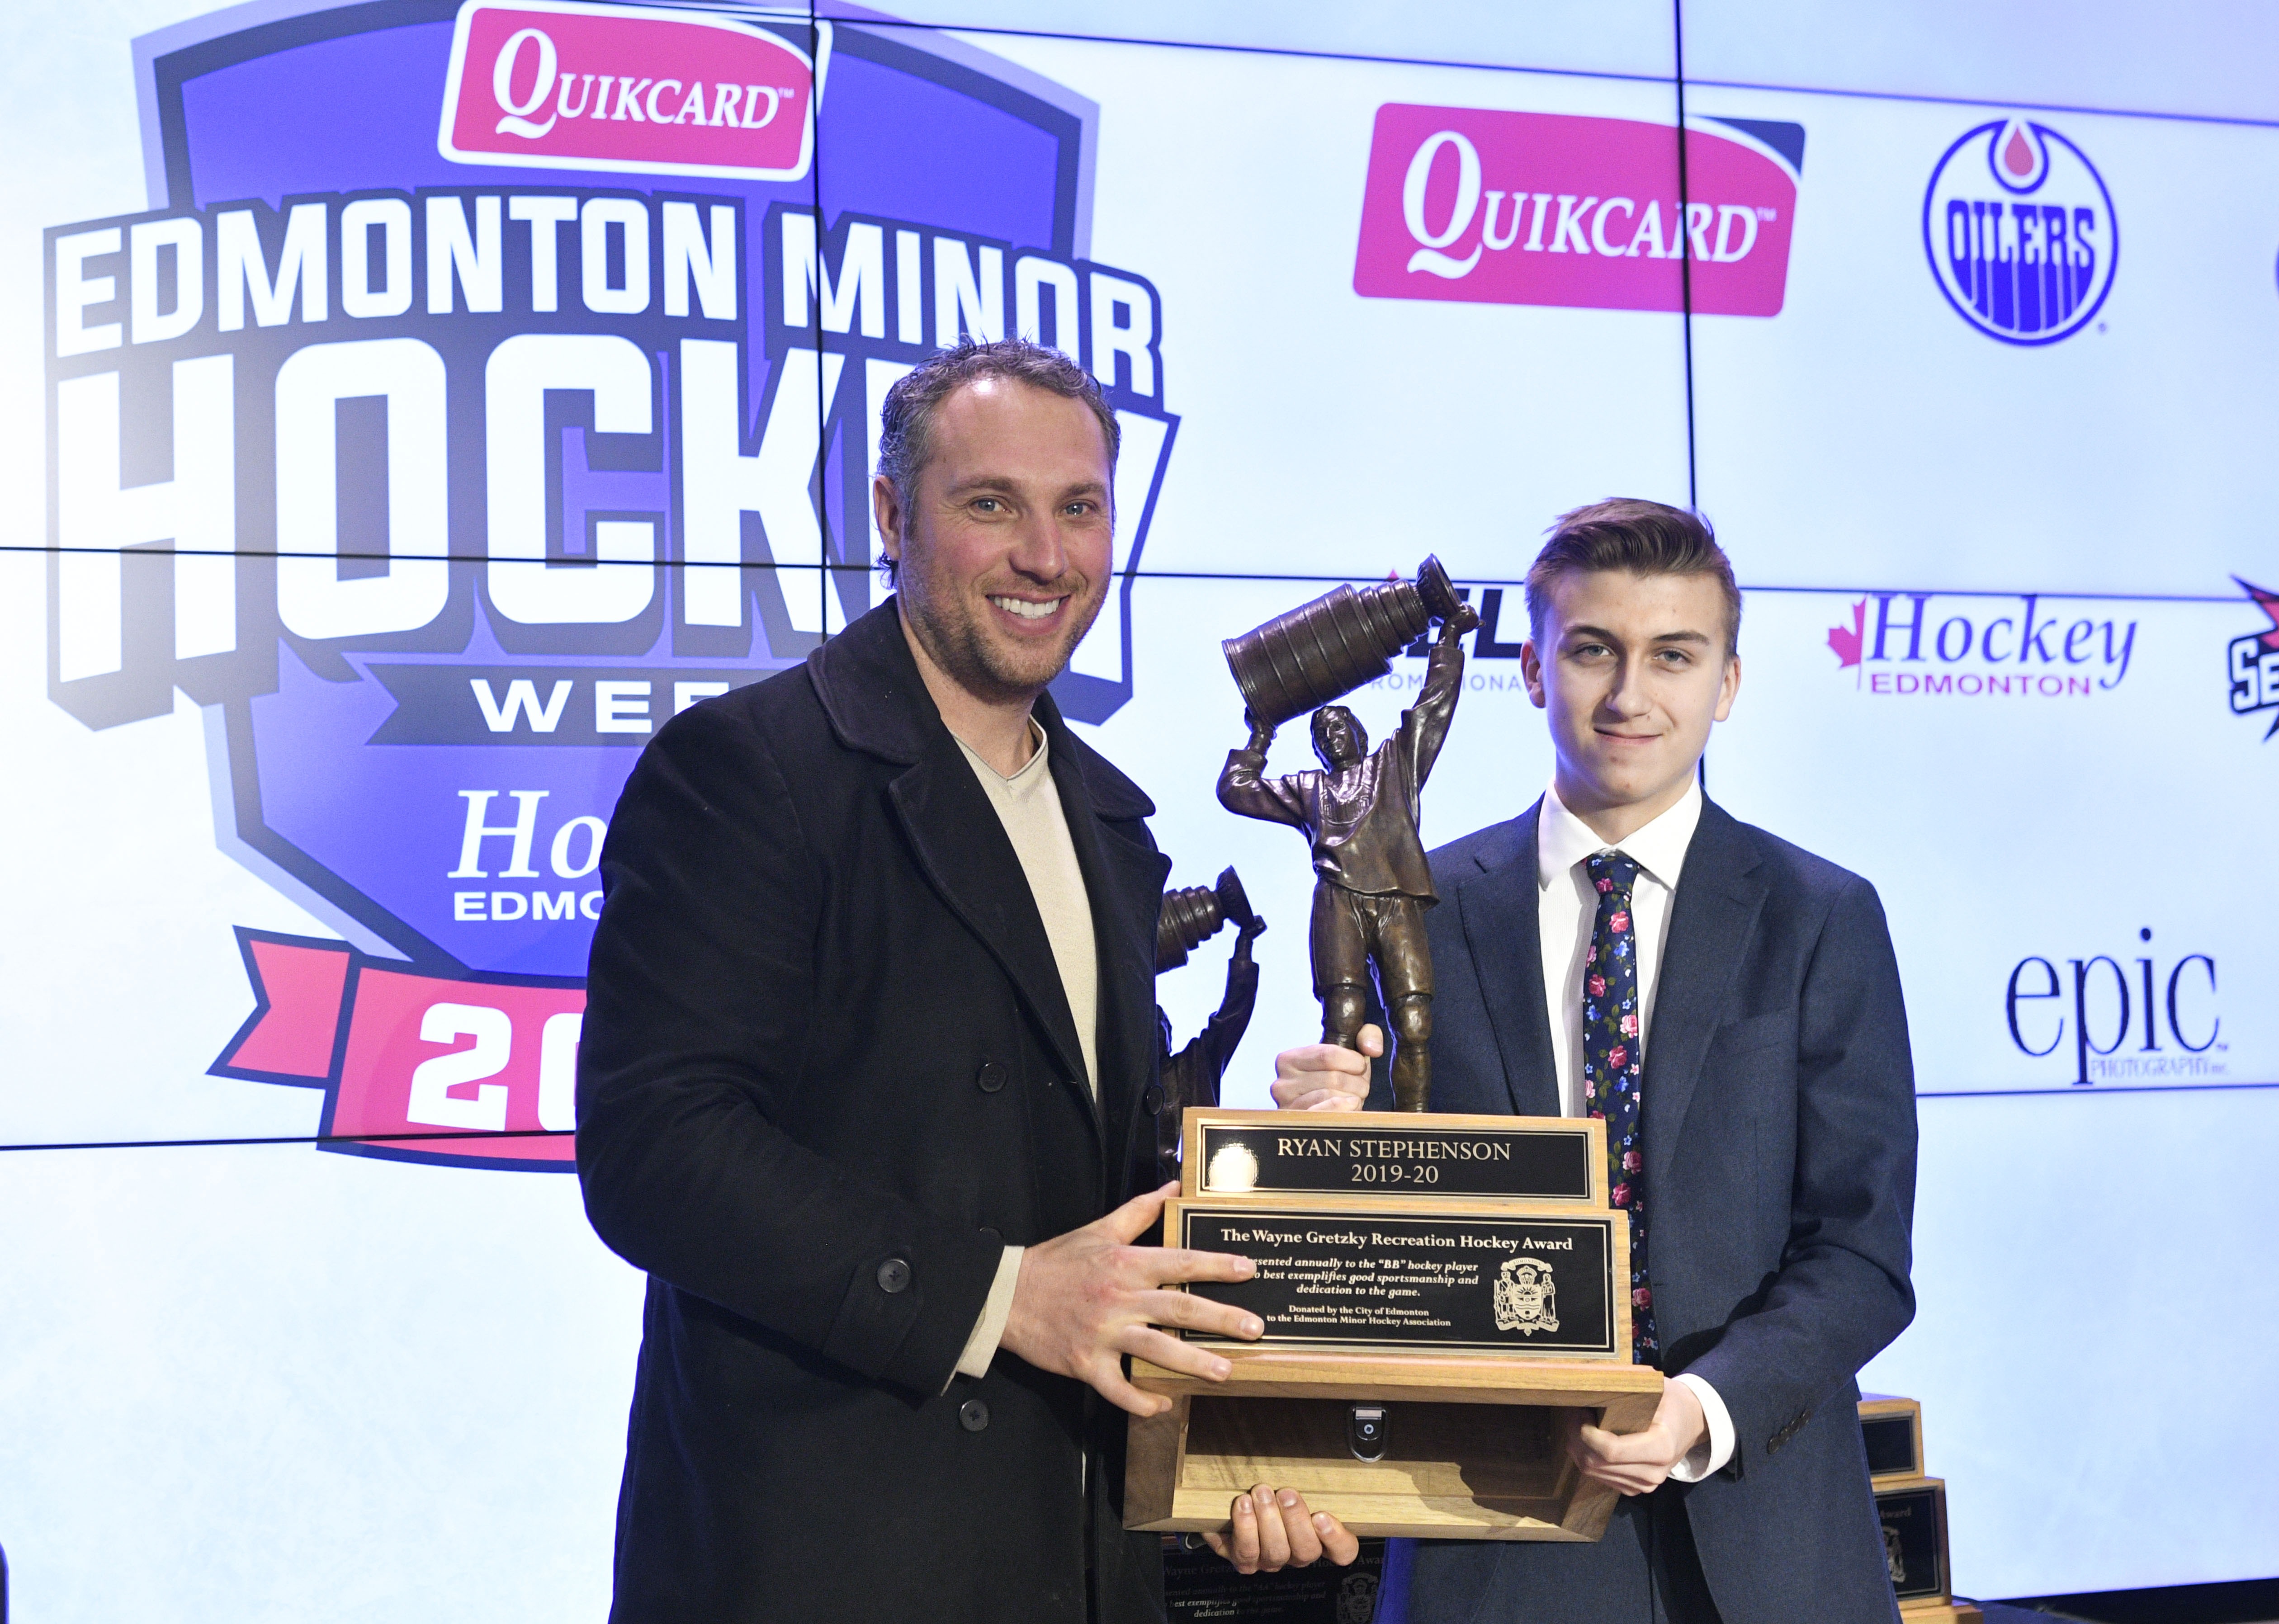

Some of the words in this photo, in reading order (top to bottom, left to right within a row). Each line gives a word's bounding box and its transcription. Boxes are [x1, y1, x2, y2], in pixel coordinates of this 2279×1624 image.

[1946, 199, 2095, 271] OILERS
[55, 195, 738, 358] EDMONTON
[781, 211, 1154, 397] MINOR
[1865, 593, 2138, 690] Hockey
[1870, 673, 2092, 697] EDMONTON
[2005, 927, 2220, 1084] epic
[1277, 1138, 1342, 1157] RYAN
[1350, 1139, 1511, 1161] STEPHENSON
[1351, 1164, 1439, 1183] 2019-20
[1220, 1228, 1250, 1242] The
[1252, 1229, 1302, 1247] Wayne
[1306, 1231, 1368, 1249] Gretzky
[1371, 1232, 1456, 1248] Recreation
[1460, 1235, 1519, 1253] Hockey
[1522, 1237, 1573, 1251] Award
[1294, 1257, 1343, 1270] annually
[1345, 1259, 1356, 1268] to
[1358, 1258, 1376, 1269] the
[1407, 1260, 1442, 1274] hockey
[1444, 1261, 1479, 1275] player
[1263, 1270, 1285, 1279] best
[1287, 1270, 1347, 1284] exemplifies
[1348, 1272, 1375, 1285] good
[1376, 1274, 1455, 1288] sportsmanship
[1457, 1275, 1479, 1284] and
[1296, 1284, 1352, 1295] dedication
[1355, 1287, 1366, 1295] to
[1368, 1285, 1386, 1296] the
[1388, 1288, 1421, 1299] game.
[1277, 1314, 1292, 1322] the
[1293, 1315, 1338, 1323] Edmonton
[1339, 1316, 1366, 1324] Minor
[1368, 1317, 1401, 1327] Hockey
[1402, 1318, 1452, 1327] Association
[1288, 1304, 1325, 1314] Donated
[1326, 1305, 1338, 1316] by
[1339, 1305, 1353, 1314] the
[1355, 1306, 1373, 1317] City
[1374, 1307, 1385, 1315] of
[1385, 1308, 1429, 1317] Edmonton
[1193, 1608, 1235, 1618] dedication
